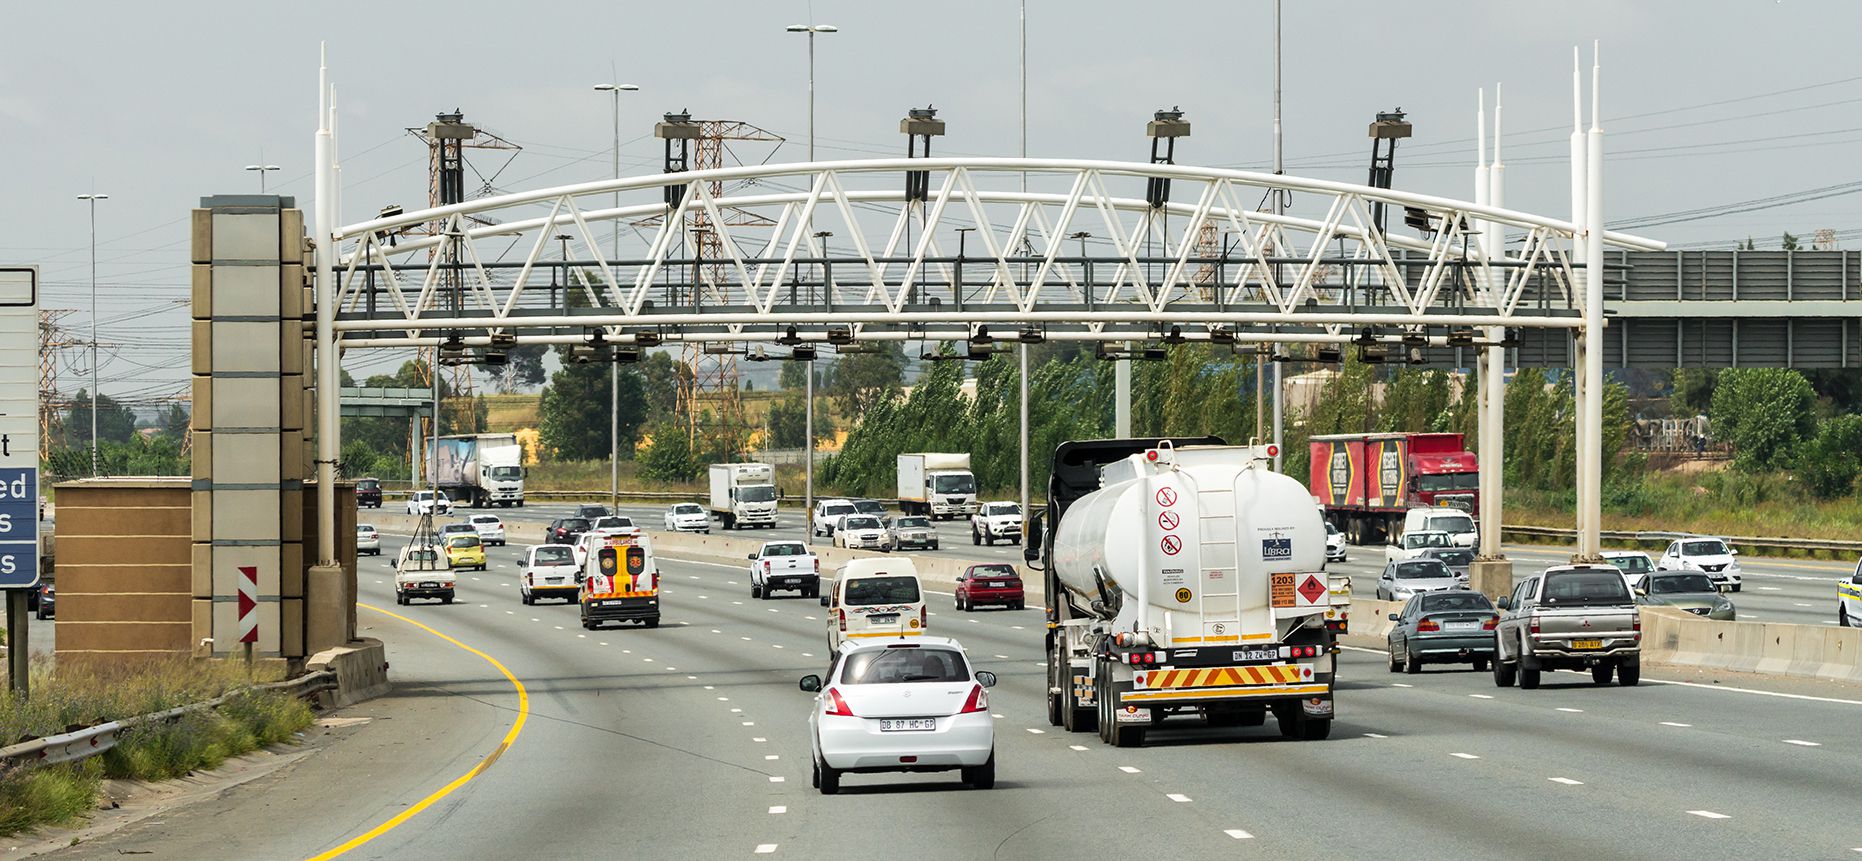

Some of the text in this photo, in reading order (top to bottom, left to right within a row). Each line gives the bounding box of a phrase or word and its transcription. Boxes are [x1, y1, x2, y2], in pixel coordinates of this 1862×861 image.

[1271, 576, 1293, 584] 1203
[1179, 591, 1189, 599] 80
[1267, 650, 1276, 659] GP
[882, 720, 934, 729] DB 87 HC GP
